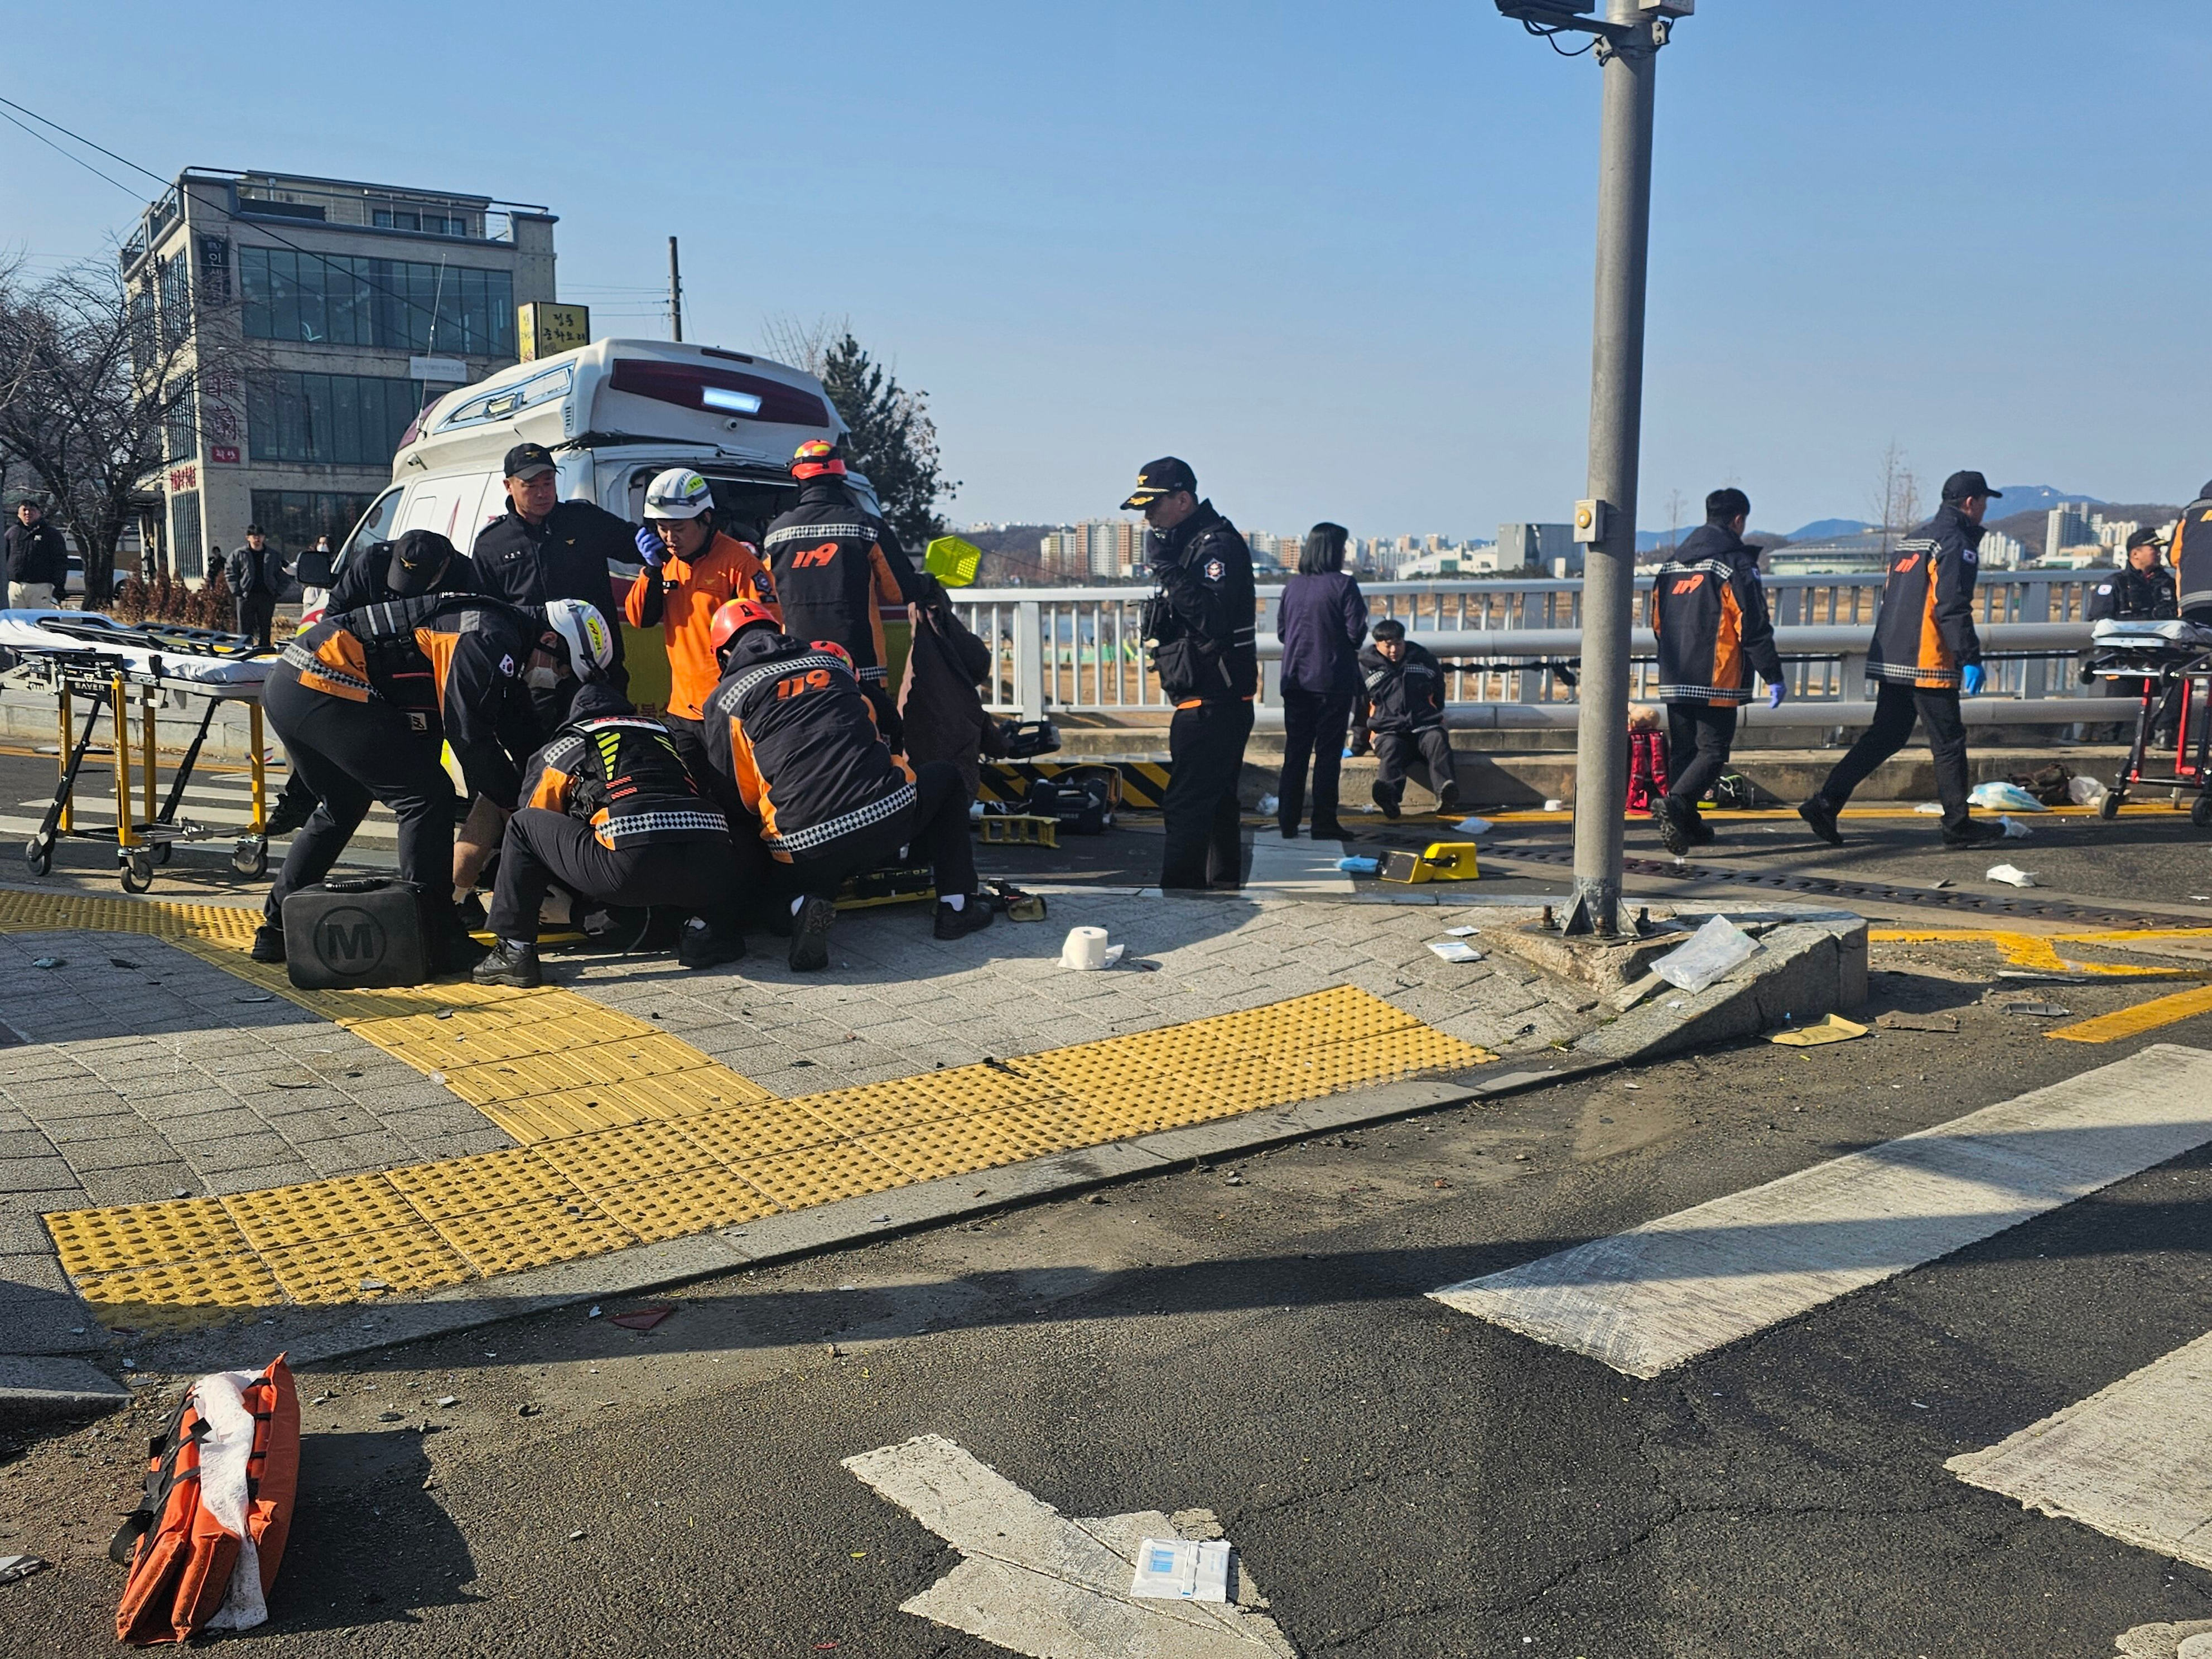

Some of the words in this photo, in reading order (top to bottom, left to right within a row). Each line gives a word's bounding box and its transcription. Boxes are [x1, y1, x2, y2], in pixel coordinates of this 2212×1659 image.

[791, 542, 838, 568] 119
[1671, 574, 1704, 595] 119
[777, 669, 831, 700] 119
[327, 923, 374, 960] M
